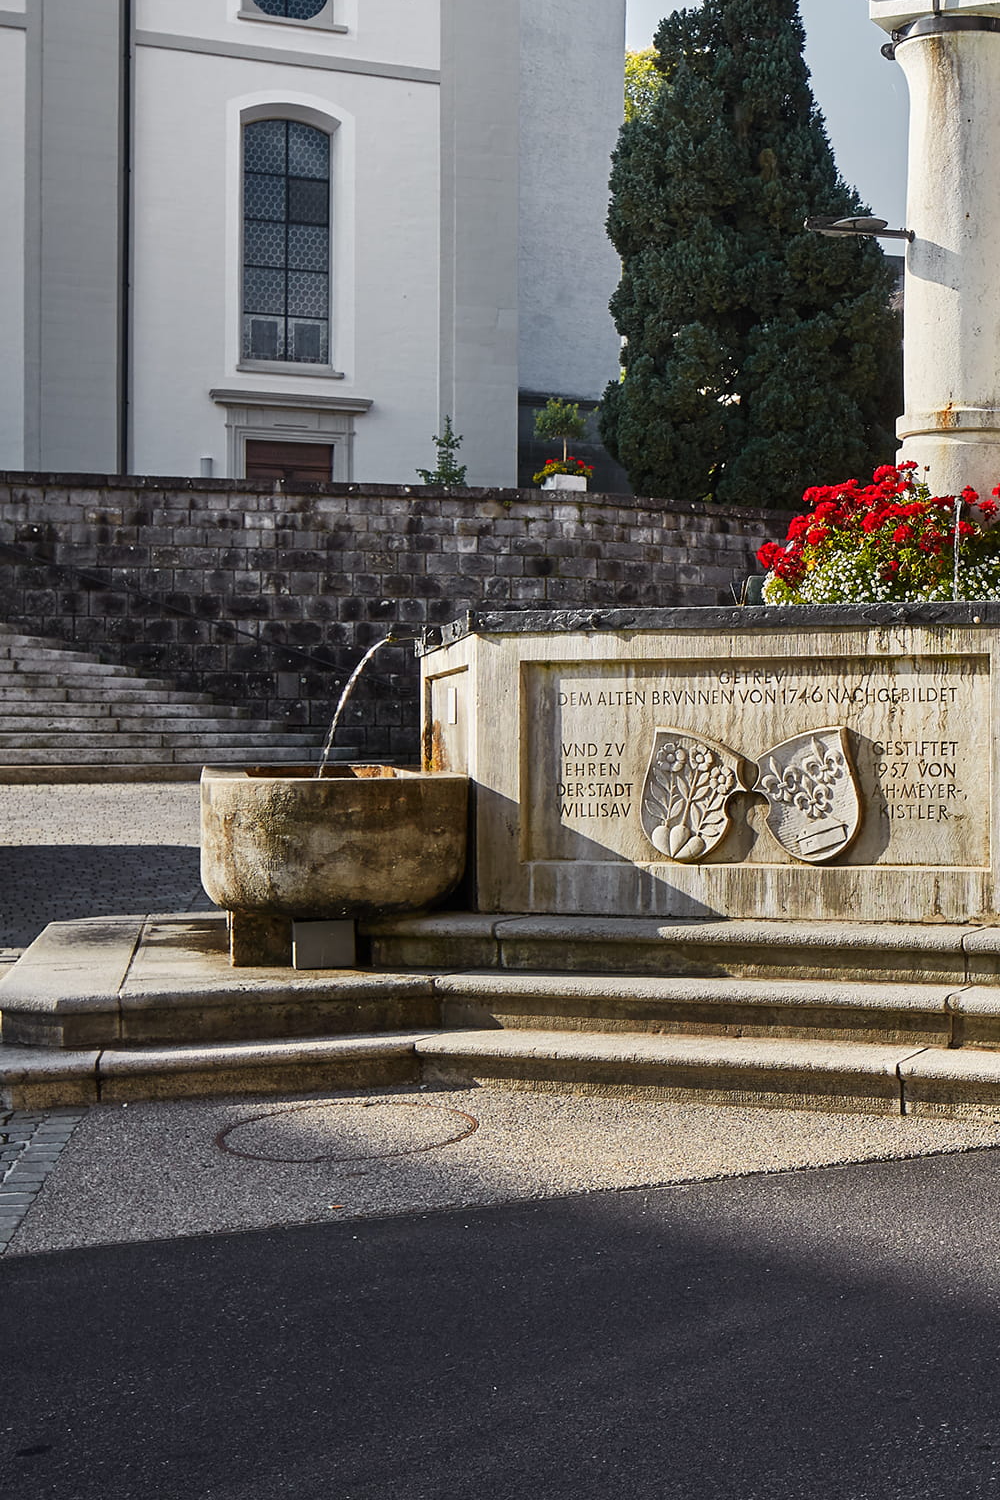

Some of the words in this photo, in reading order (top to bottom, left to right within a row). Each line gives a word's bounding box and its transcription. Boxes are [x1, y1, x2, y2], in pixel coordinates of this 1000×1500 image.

[718, 670, 785, 685] GETREV
[557, 691, 593, 706] DEM
[596, 690, 647, 706] ALTEN
[652, 690, 732, 705] BRVNNEN
[738, 689, 777, 705] VON
[781, 686, 823, 706] 1746
[826, 687, 958, 704] NACHGEBILDET
[562, 742, 598, 757] VND
[604, 742, 626, 757] ZV
[872, 740, 959, 757] GESTIFTET
[565, 762, 621, 777] EHREN
[872, 762, 909, 778] 1957
[917, 761, 957, 778] VON
[556, 802, 632, 818] WILLISAV
[879, 803, 949, 820] KISTLER
